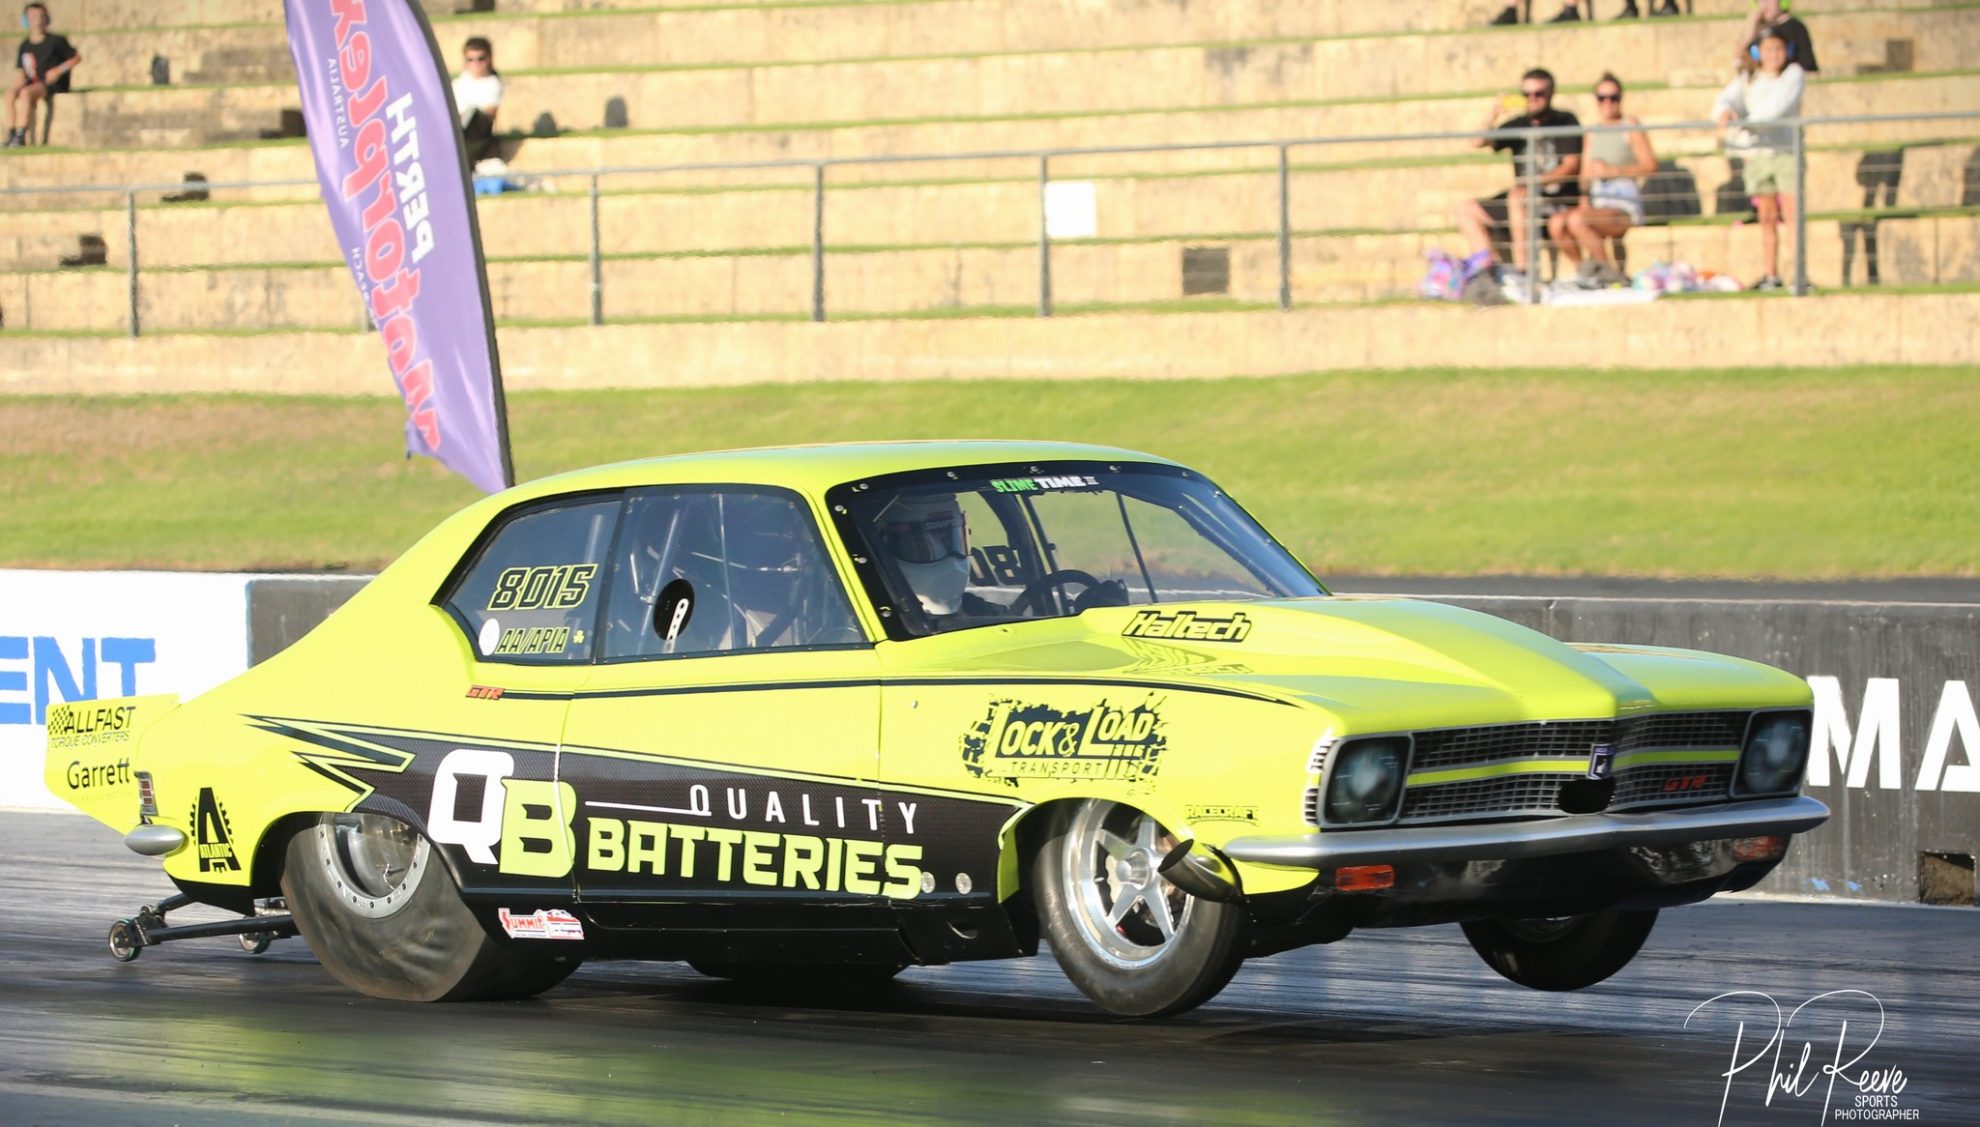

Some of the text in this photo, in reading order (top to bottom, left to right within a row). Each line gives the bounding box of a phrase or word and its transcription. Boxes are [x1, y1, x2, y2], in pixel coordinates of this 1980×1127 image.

[487, 564, 598, 611] 8015
[1121, 610, 1252, 643] Haltech
[465, 685, 505, 700] GTR
[64, 706, 136, 735] ALLFAST
[67, 758, 130, 789] Garrett
[1011, 761, 1103, 775] TRANSPORT
[1664, 774, 1709, 791] GTR
[690, 784, 918, 835] QUALITY
[1184, 805, 1259, 820] RACECRAFT
[587, 817, 923, 900] BATTERIES
